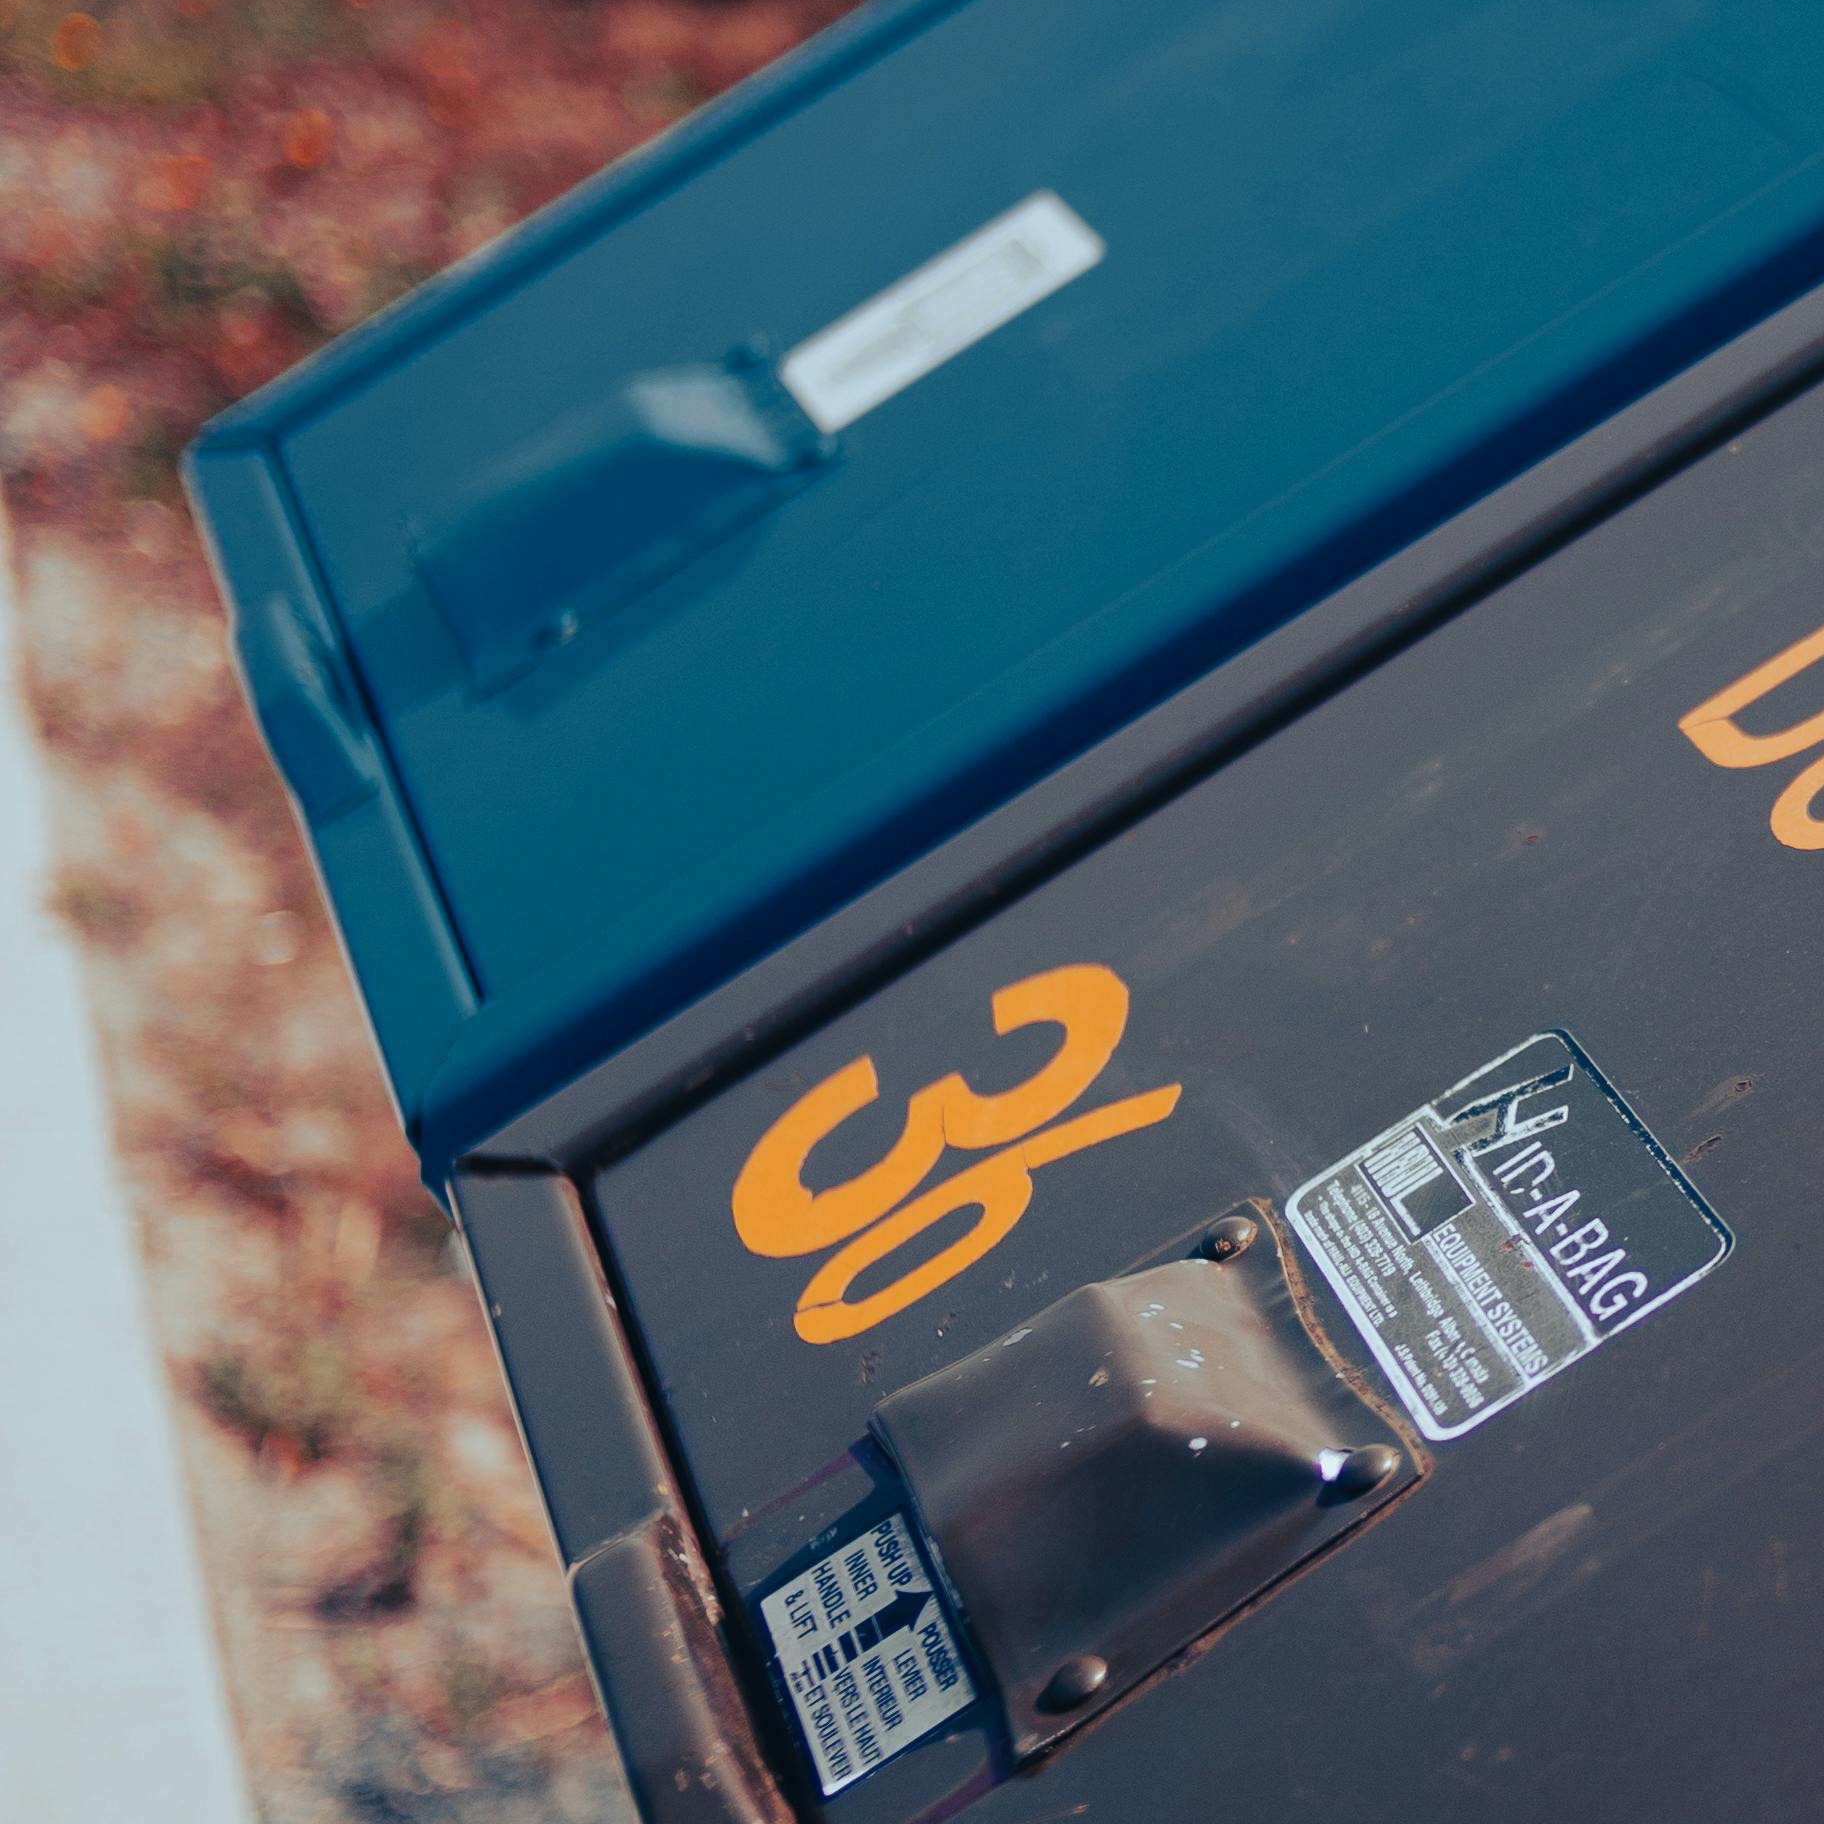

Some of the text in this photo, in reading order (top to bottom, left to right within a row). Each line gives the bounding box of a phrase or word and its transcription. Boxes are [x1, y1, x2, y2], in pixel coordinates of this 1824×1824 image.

[732, 965, 1180, 1344] 36
[1326, 1179, 1358, 1223] Telephone
[1371, 1216, 1397, 1249] Avenue
[1391, 1244, 1414, 1275] North,
[1408, 1270, 1444, 1318] Lethbridge
[1432, 1223, 1548, 1374] EQUIPMENT SYSTEMS
[1425, 1329, 1442, 1350] Fax
[844, 1548, 878, 1601] INNER
[870, 1519, 913, 1585] PUSH UP
[784, 1589, 818, 1639] & LIFT
[811, 1561, 851, 1628] HANDLE
[893, 1648, 927, 1701] LEVIER
[917, 1621, 958, 1691] POUSSER
[832, 1665, 881, 1764] VERS LE HAUT
[861, 1654, 902, 1730] INTERIEUR
[803, 1683, 851, 1780] ET SOULEVER
